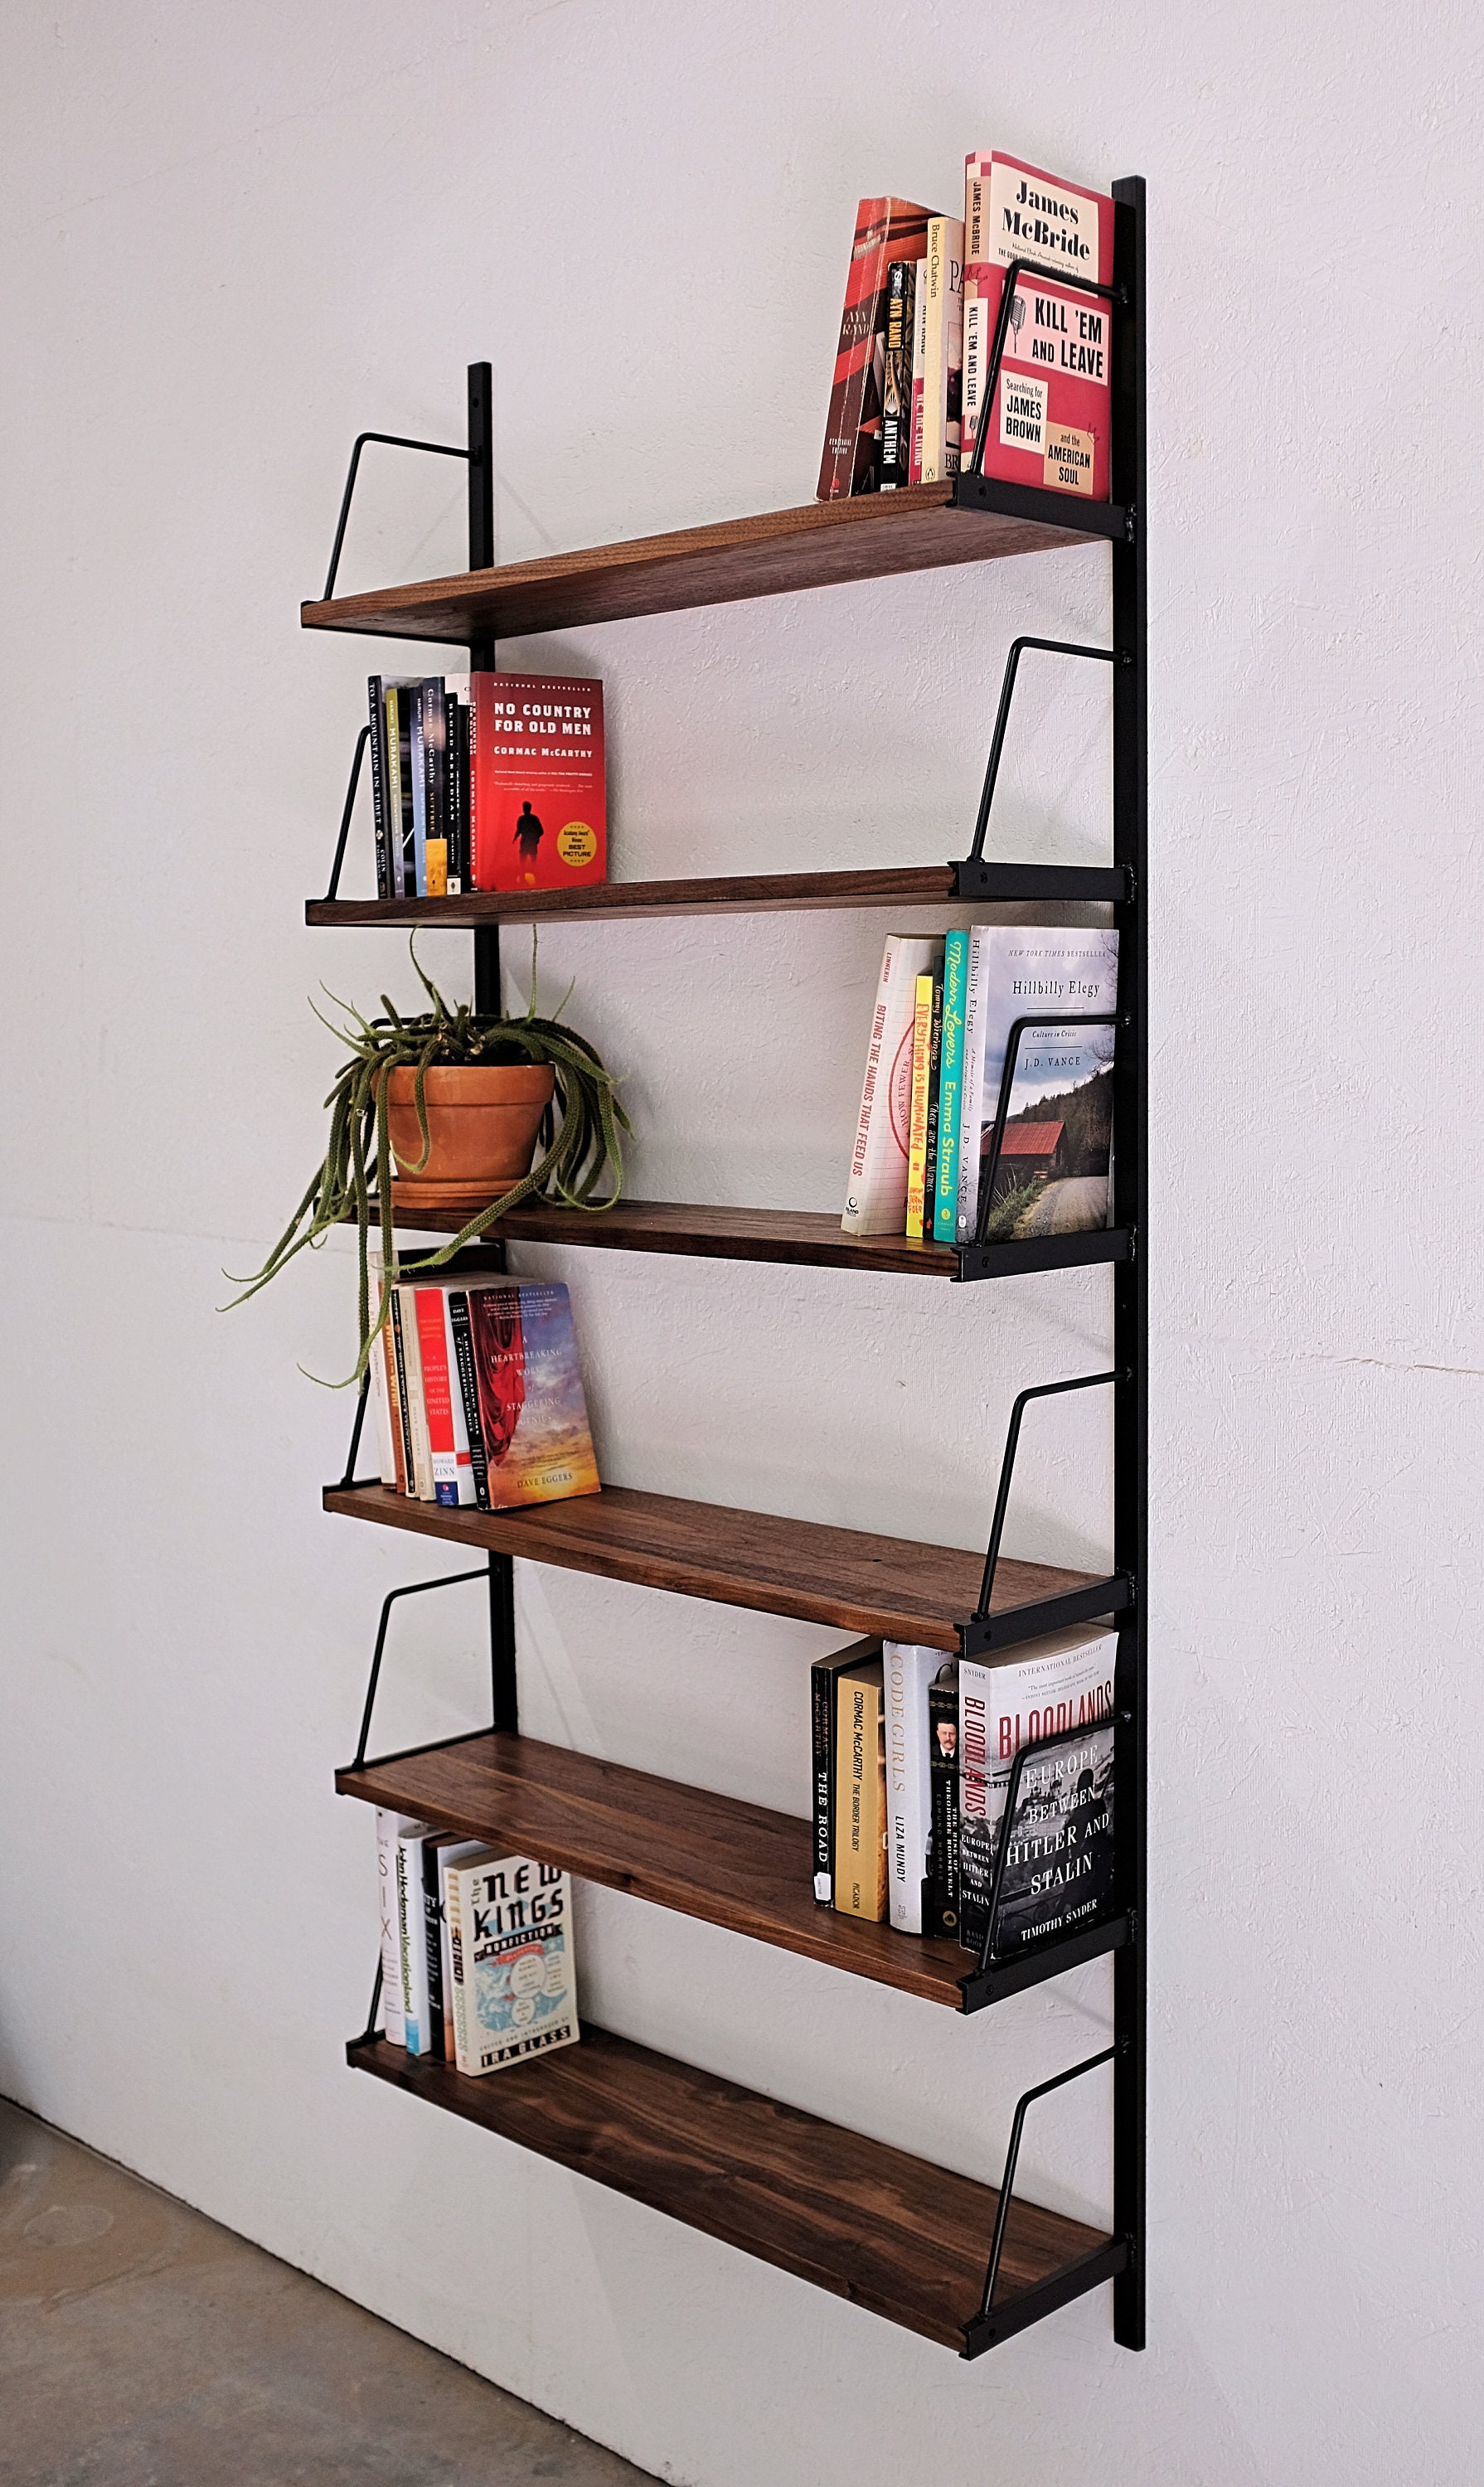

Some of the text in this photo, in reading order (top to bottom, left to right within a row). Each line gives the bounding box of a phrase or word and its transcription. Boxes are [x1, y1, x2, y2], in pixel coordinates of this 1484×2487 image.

[1016, 180, 1079, 224] James
[1002, 207, 1090, 260] McBride
[931, 225, 940, 298] Bruce Chatwin
[842, 324, 870, 335] RAND
[846, 311, 866, 322] AYN
[889, 298, 903, 349] AYN RAND
[969, 307, 978, 328] KILL
[1035, 297, 1102, 344] KILL 'EM
[968, 355, 977, 373] AND
[1032, 339, 1103, 378] AND LEAVE
[967, 378, 976, 407] LEAVE
[1006, 379, 1033, 397] Searching
[1007, 395, 1042, 420] JAMES
[883, 420, 898, 464] ANTHEM
[1006, 419, 1041, 443] BROWN
[1060, 434, 1080, 446] and the
[914, 434, 923, 466] LIVING
[1048, 444, 1090, 468] AMERICAN
[1059, 468, 1079, 486] SOUL
[494, 703, 591, 719] NO COUNTRY
[369, 683, 375, 697] TO
[374, 776, 379, 787] IN
[495, 720, 591, 735] FOR OLD MEN
[390, 728, 398, 788] MURAKAMI
[494, 746, 592, 758] CORMAC McCARTHY
[883, 953, 892, 983] LINNEKIN
[967, 940, 980, 1034] Hillbilly Elegy
[1013, 981, 1099, 998] Hillbilly Elegy
[931, 984, 944, 1071] Tommy Wieringa
[941, 941, 962, 1196] Modern Lovers Emma Straub
[1025, 1057, 1080, 1070] J.D. VANCE
[853, 1004, 886, 1176] BITING THE HANDS THAT FEED US
[898, 1101, 909, 1127] HOW
[926, 1166, 936, 1192] Names
[960, 1156, 969, 1203] VANCE
[491, 1349, 562, 1363] HEARTBREAKING
[459, 1348, 469, 1398] STAGGERING
[465, 1341, 476, 1408] HEARTBREAKING
[390, 1374, 398, 1407] WHAT
[507, 1398, 560, 1411] STAGGERING
[517, 1473, 573, 1488] DAVE EGGERS
[964, 1668, 986, 1680] SNYDER
[1018, 1658, 1072, 1677] INTERNATIONAL
[1073, 1644, 1102, 1662] BESTSELLER
[854, 1691, 863, 1731] CORMAC
[890, 1655, 905, 1792] CODE GIRLS
[853, 1733, 863, 1781] McCARTHY
[964, 1696, 986, 1816] BLOODLANDS
[1026, 1745, 1098, 1789] EUROPE
[818, 1772, 828, 1862] THE ROAD
[852, 1796, 860, 1823] BORDER
[1029, 1785, 1096, 1825] BETWEEN
[895, 1816, 906, 1883] LIZA MUNDY
[962, 1834, 990, 1851] EUROPE
[1006, 1813, 1109, 1866] HITLER AND
[953, 1862, 958, 1873] OF
[962, 1849, 989, 1864] BETWEEN
[963, 1862, 989, 1878] HITLER
[483, 1863, 562, 1902] NEW
[970, 1878, 982, 1888] AND
[1031, 1852, 1093, 1894] STALIN
[471, 1879, 482, 1906] the
[963, 1890, 990, 1906] STALIN
[473, 1888, 563, 1942] KINGS
[1021, 1899, 1097, 1941] TIMOTHY SNYDER
[486, 1925, 553, 1954] NONFICTION
[402, 1936, 413, 2014] Vacationland
[483, 2027, 568, 2066] IRA GLASS
